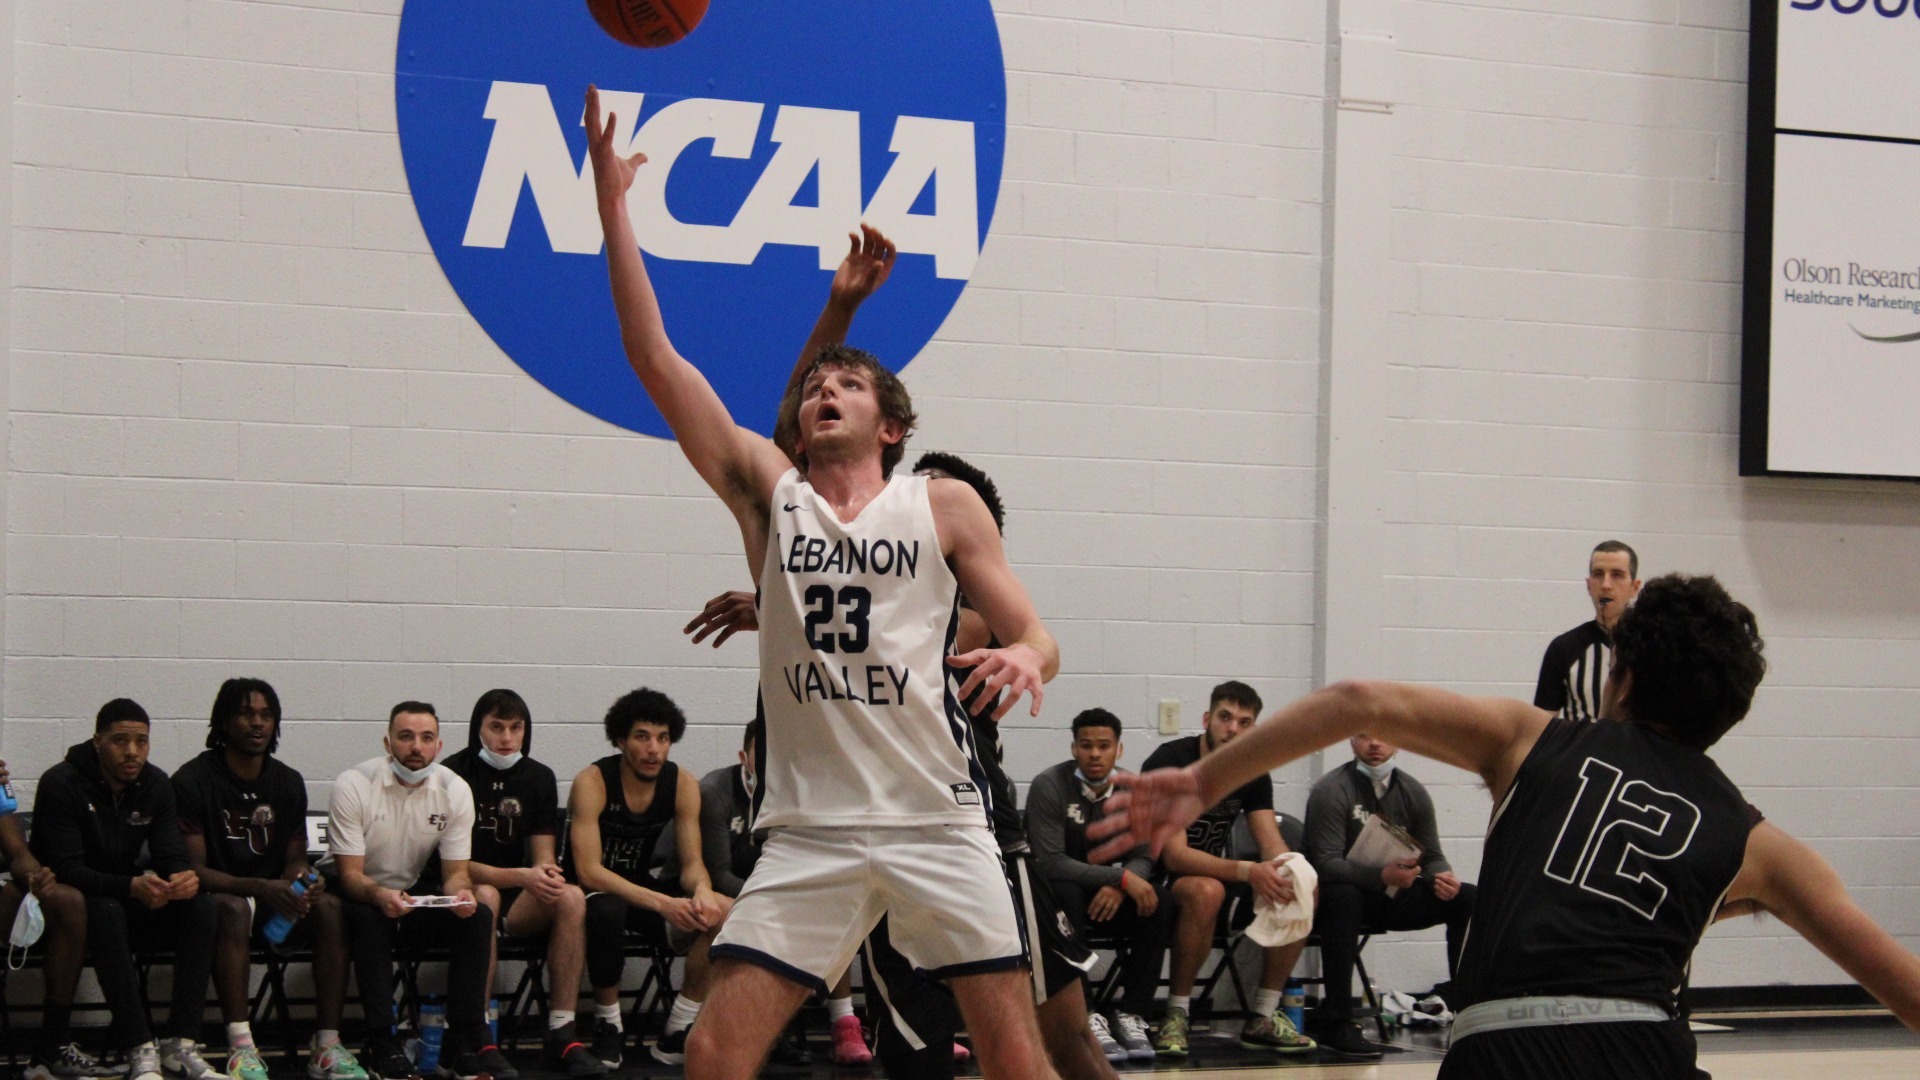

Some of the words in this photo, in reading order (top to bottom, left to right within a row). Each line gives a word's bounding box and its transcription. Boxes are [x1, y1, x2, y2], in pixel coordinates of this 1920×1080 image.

[462, 80, 979, 280] NCAA
[1783, 258, 1841, 285] Olson
[1784, 288, 1854, 307] Healthcare
[776, 532, 919, 579] LEBANON
[804, 584, 872, 654] 23
[783, 661, 909, 706] VALLEY
[956, 783, 972, 791] XL
[1543, 756, 1701, 920] 12
